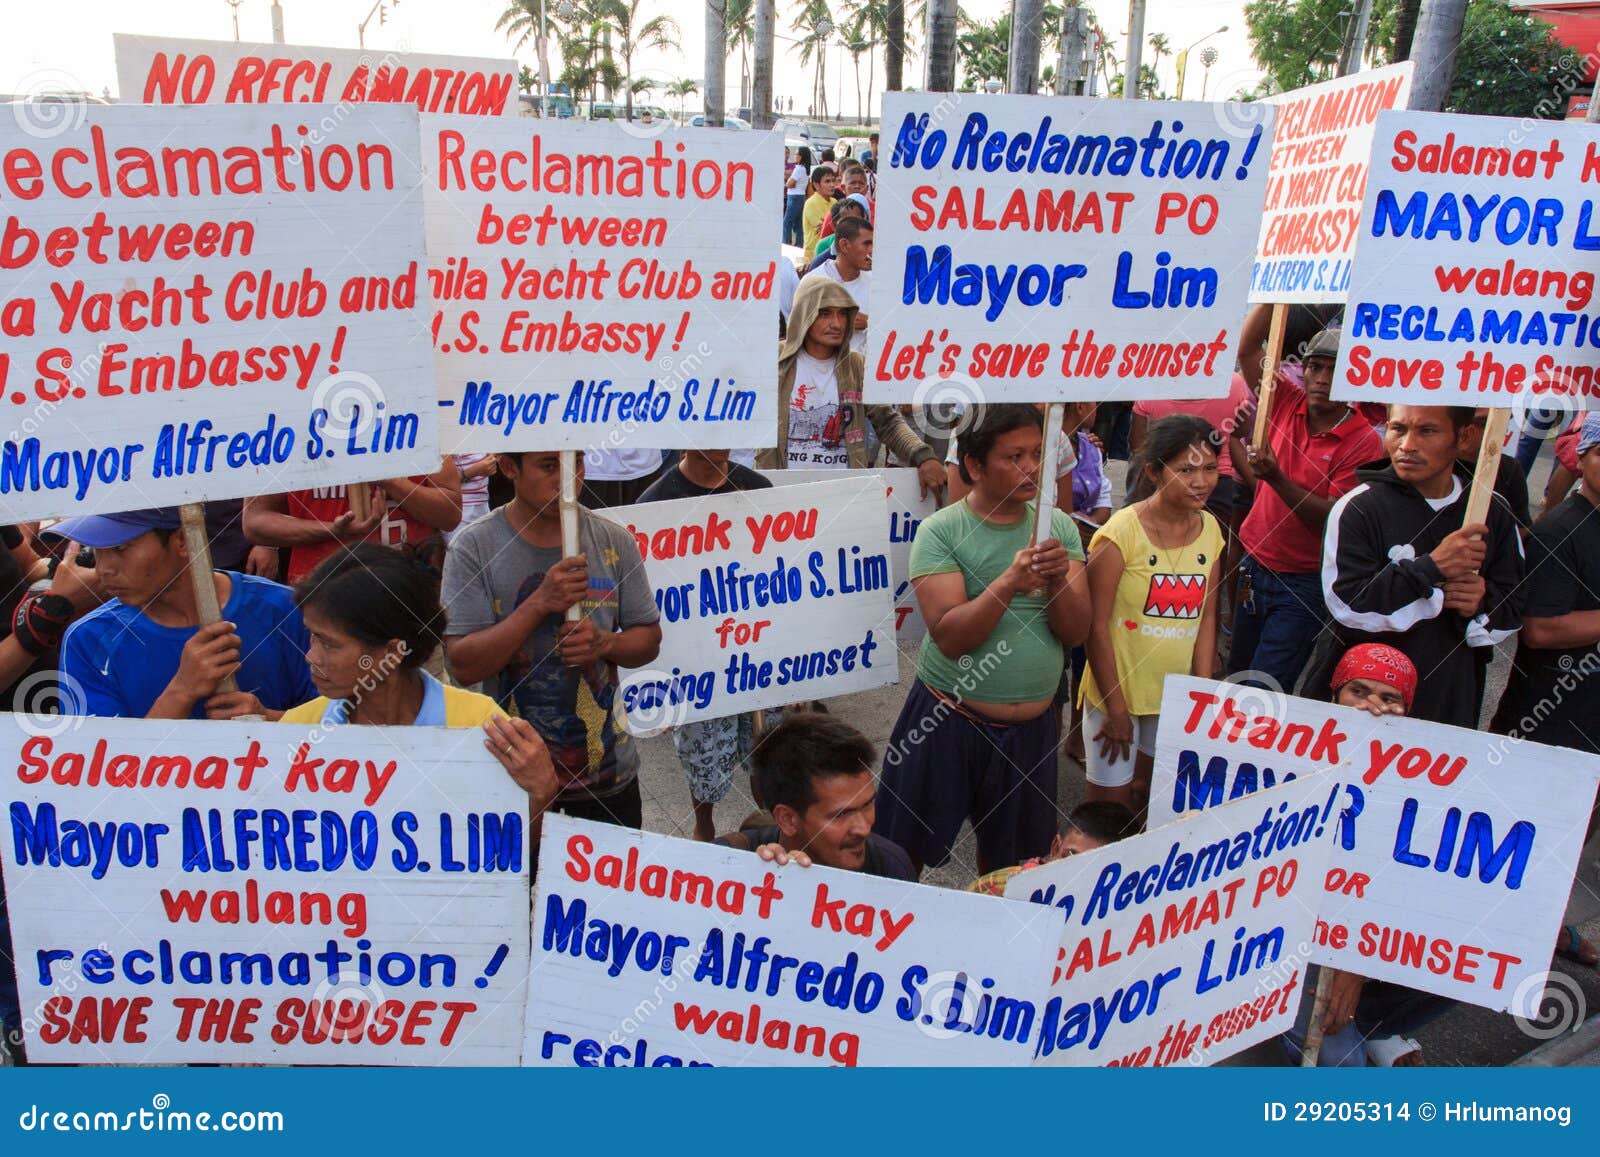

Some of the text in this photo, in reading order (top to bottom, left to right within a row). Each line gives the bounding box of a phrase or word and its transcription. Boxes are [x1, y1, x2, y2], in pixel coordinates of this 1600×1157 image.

[143, 52, 215, 103] NO
[0, 124, 393, 199] eclamation
[438, 129, 754, 203] Reclamation
[890, 112, 946, 169] No
[1270, 135, 1347, 171] ETWEEN
[1392, 130, 1564, 180] Salamat
[910, 185, 1219, 235] SALAMAT PO
[1284, 165, 1340, 208] YACHT
[0, 212, 254, 268] between
[476, 203, 668, 247] between
[1371, 190, 1564, 246] MAYOR
[51, 275, 213, 334] Yacht
[225, 268, 327, 322] Club
[339, 261, 417, 313] and
[427, 256, 776, 300] nila Yacht Club and
[902, 245, 1218, 322] Mayor Lim
[1258, 261, 1314, 291] ALFREDO
[1434, 259, 1594, 311] walang
[97, 326, 347, 397] Embassy!
[876, 329, 1228, 381] Let's save the sunset
[1346, 345, 1444, 390] Save
[1457, 351, 1527, 392] the
[459, 381, 560, 436] Mayor
[562, 379, 671, 424] Alfredo
[704, 378, 756, 422] Lim
[1, 402, 419, 501] Mayor Alfredo S. Lim
[627, 508, 818, 562] hank you
[700, 556, 802, 617] Alfredo
[808, 551, 834, 598] S.
[838, 546, 889, 594] Lim
[715, 617, 771, 649] for
[725, 652, 772, 694] the
[777, 630, 877, 687] sunset
[1183, 690, 1468, 787] Thank you
[17, 736, 398, 806] Salamat kay
[9, 801, 523, 880] Mayor ALFREDO S. LIM
[1392, 797, 1536, 890] LIM
[160, 878, 367, 938] walang
[565, 834, 915, 952] Salamat kay
[1253, 859, 1298, 908] PO
[1324, 867, 1371, 899] OR
[543, 893, 1036, 1044] Mayor Alfredo S. Lim
[1196, 926, 1284, 995] Lim
[1312, 914, 1521, 990] he SUNSET
[40, 996, 477, 1047] SAVE THE SUNSET
[674, 1002, 860, 1067] walang
[1202, 970, 1299, 1048] sunset
